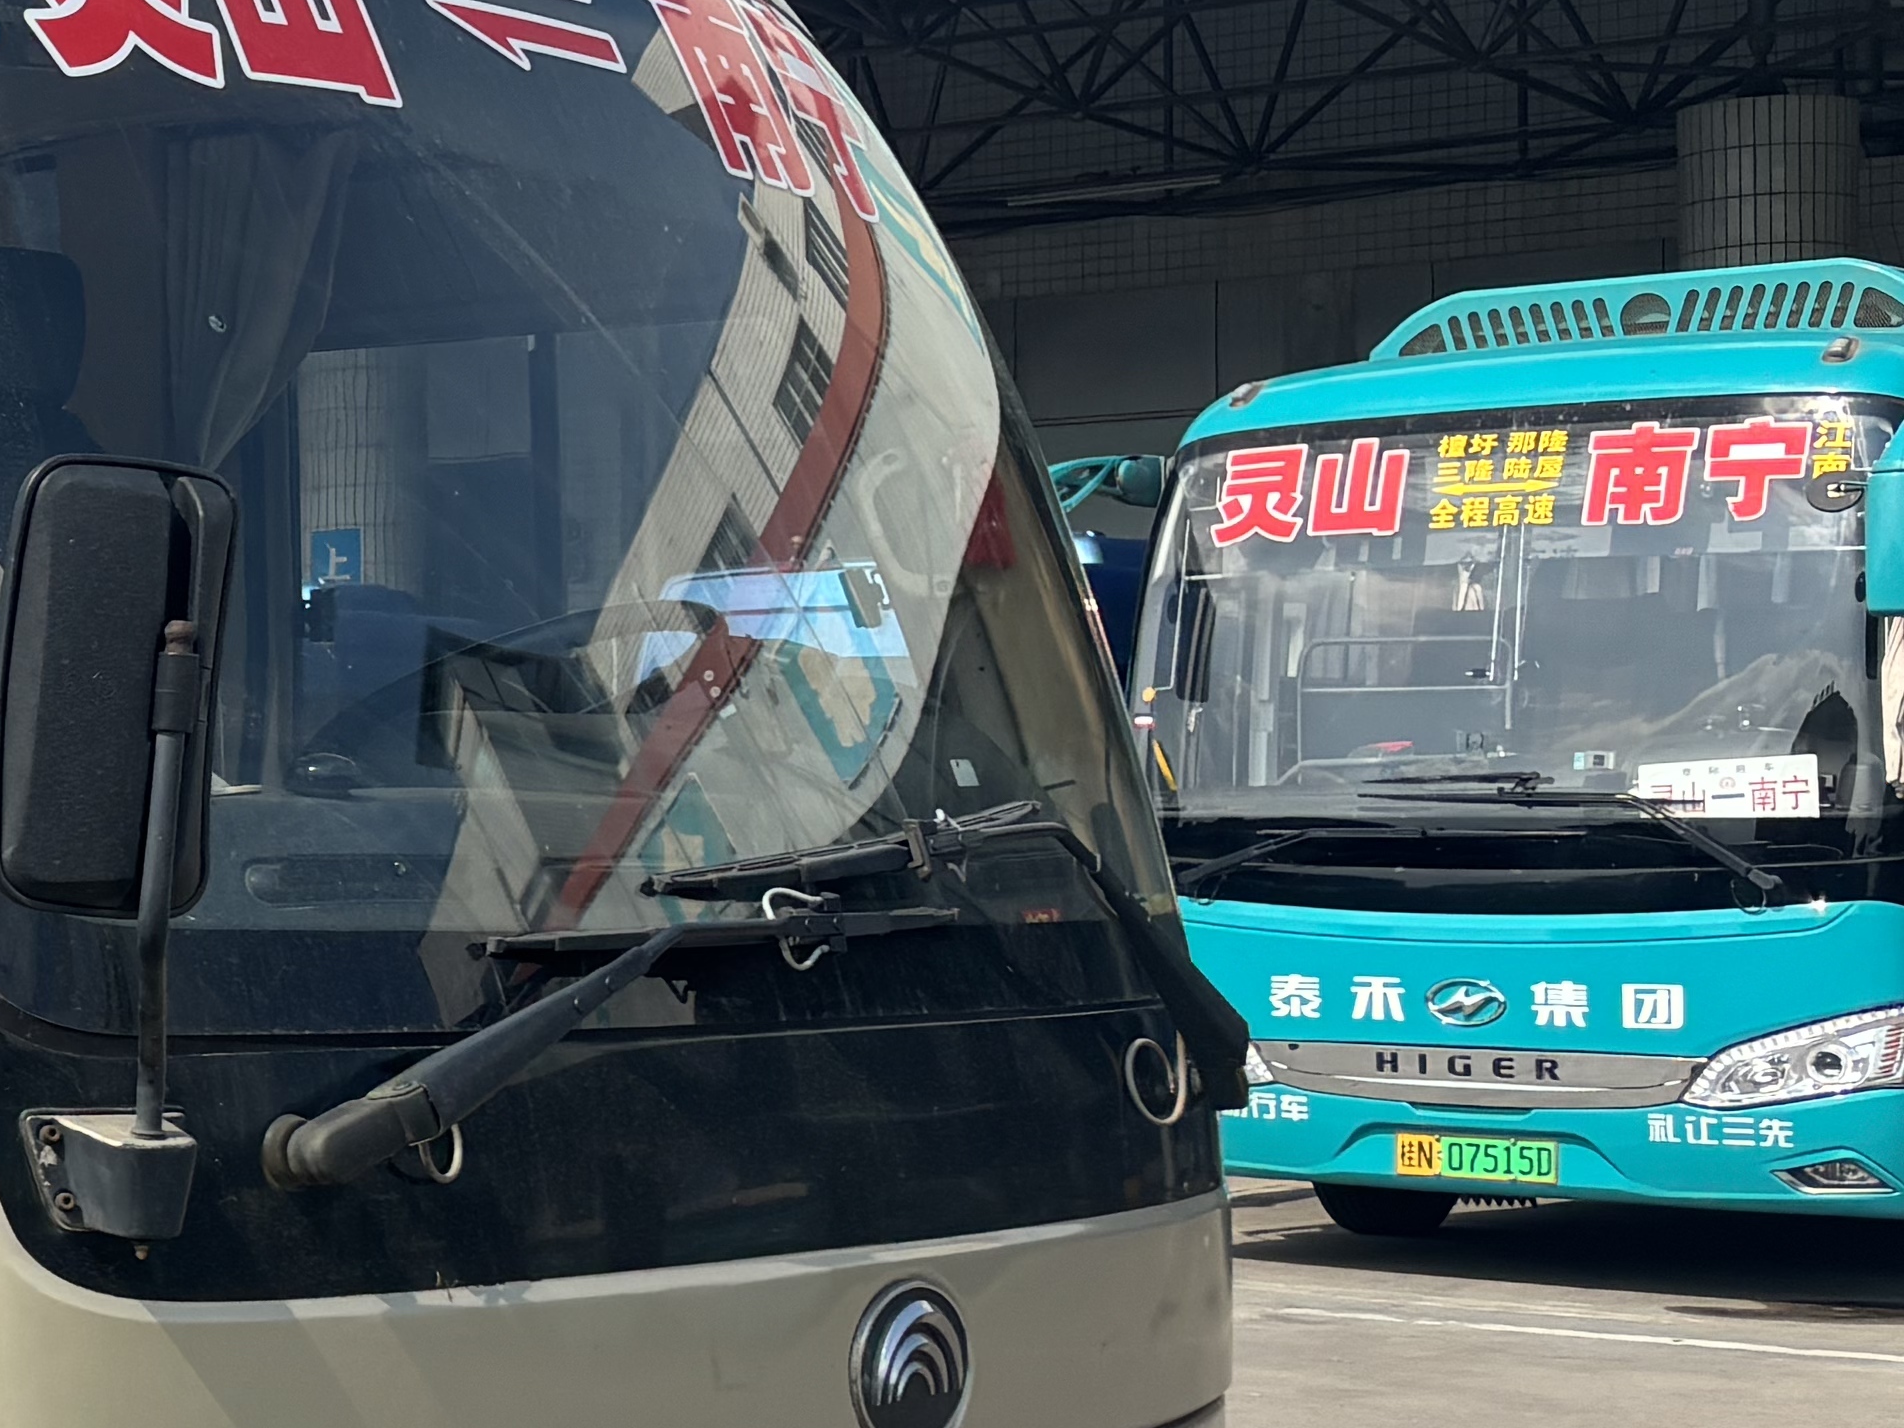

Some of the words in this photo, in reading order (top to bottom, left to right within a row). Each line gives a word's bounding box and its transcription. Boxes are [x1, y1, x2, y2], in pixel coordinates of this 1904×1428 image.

[1506, 429, 1569, 454] 那隆
[1213, 438, 1409, 546] 灵山
[1581, 417, 1813, 526] 南宁
[1433, 459, 1494, 483] 三隆
[1502, 455, 1564, 480] 陆屋
[1428, 492, 1556, 529] 全程高速
[1269, 973, 1405, 1022] 泰禾
[1530, 980, 1686, 1030] 集团
[1376, 1050, 1561, 1081] HIGER
[1220, 1091, 1309, 1121] 行车
[1647, 1113, 1796, 1149] 礼让三先
